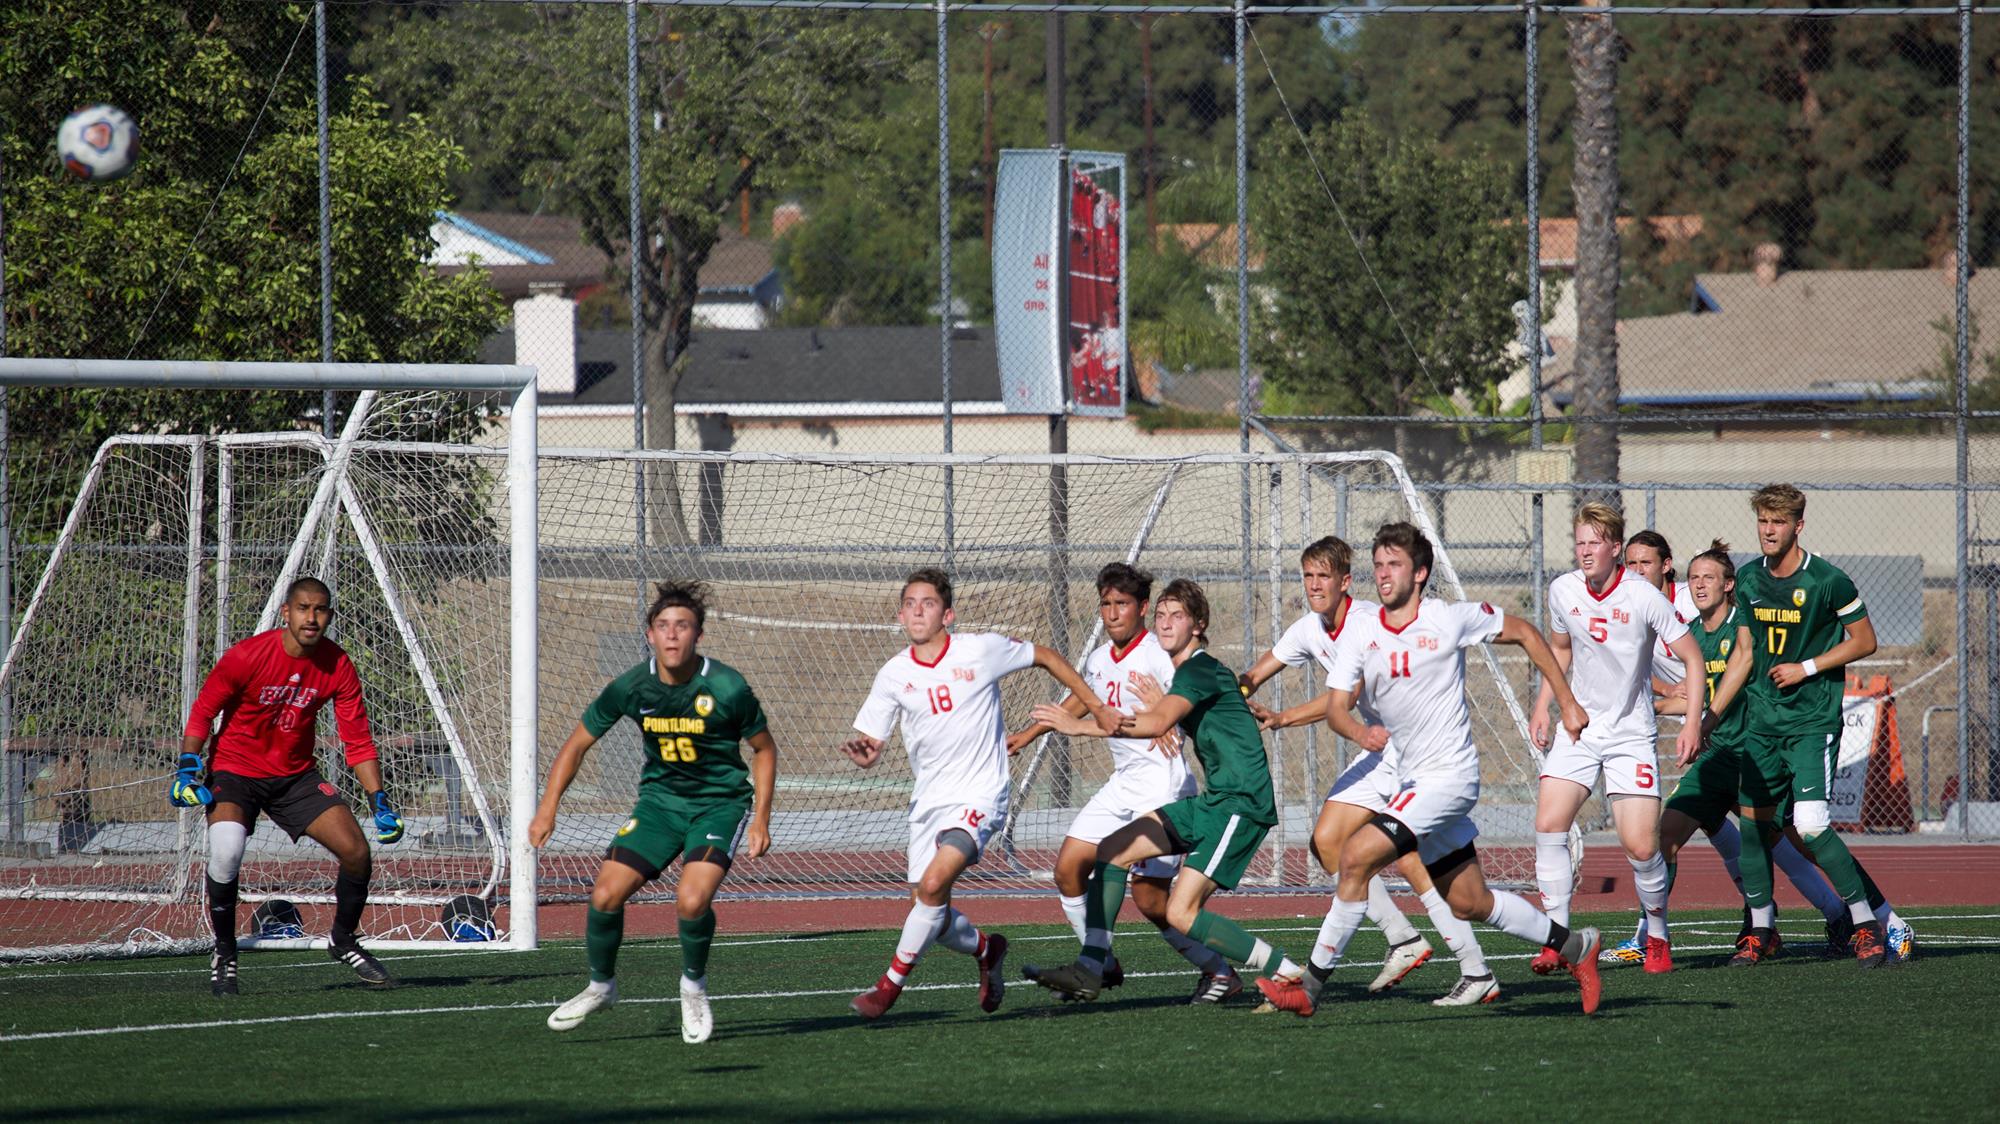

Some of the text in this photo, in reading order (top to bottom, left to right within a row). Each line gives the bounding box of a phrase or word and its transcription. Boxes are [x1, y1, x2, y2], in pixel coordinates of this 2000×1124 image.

[1613, 608, 1630, 624] BU
[1754, 608, 1800, 622] POINT LOMA
[1589, 617, 1608, 643] 5
[1768, 626, 1787, 655] 17
[1390, 651, 1411, 679] 11
[928, 684, 953, 714] 18
[1106, 681, 1122, 708] 21
[658, 737, 698, 762] 26
[1635, 763, 1653, 788] 5
